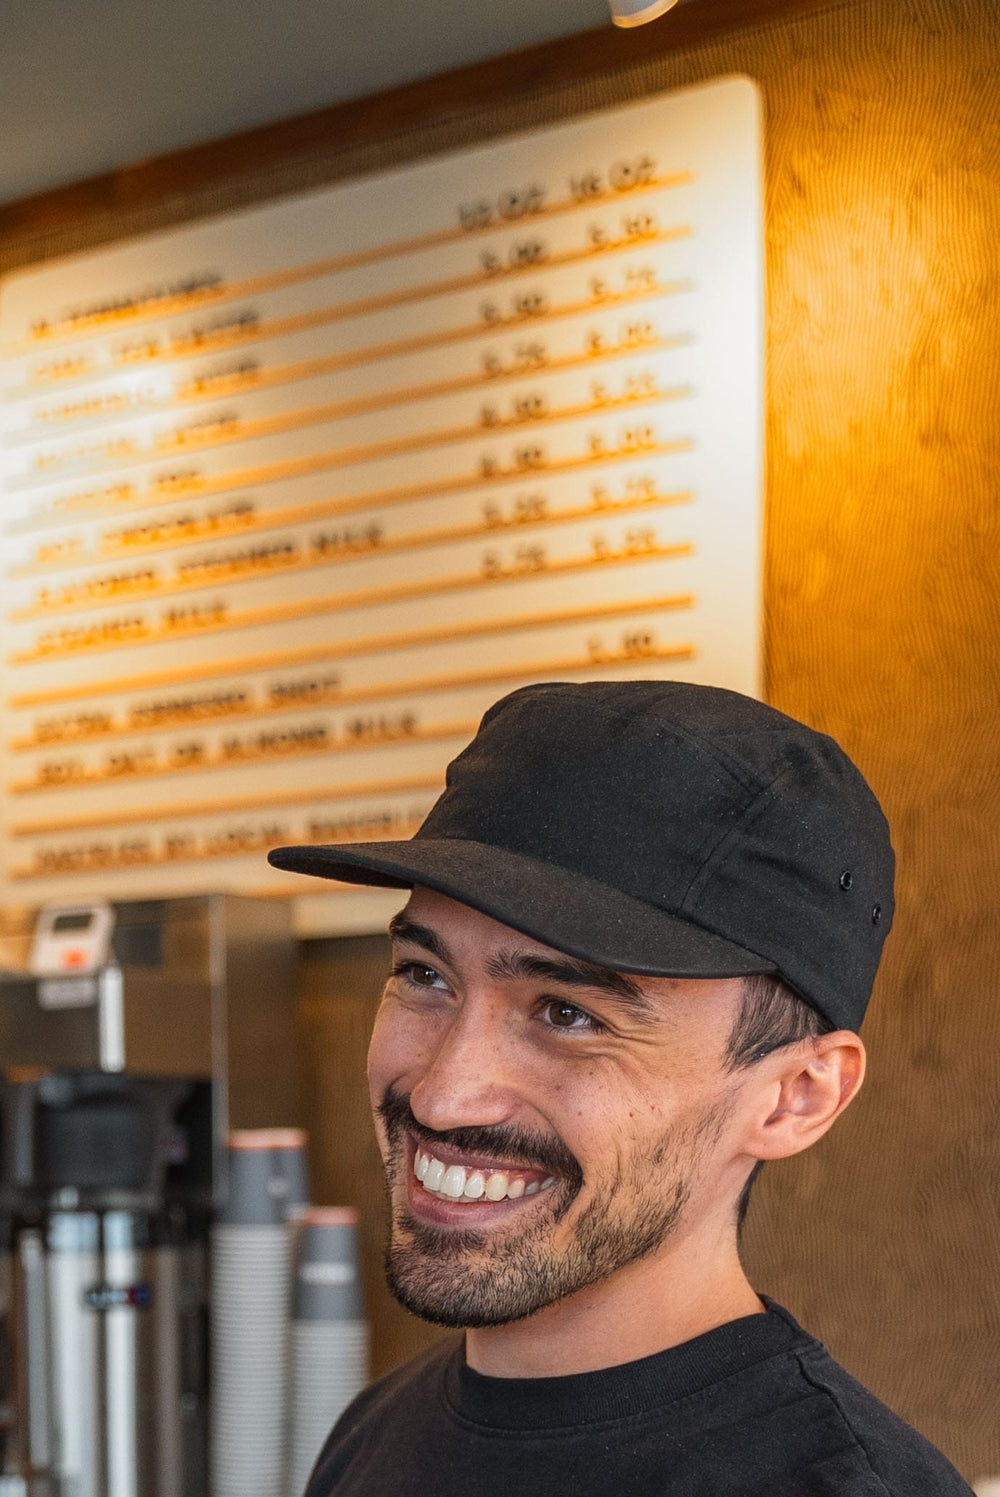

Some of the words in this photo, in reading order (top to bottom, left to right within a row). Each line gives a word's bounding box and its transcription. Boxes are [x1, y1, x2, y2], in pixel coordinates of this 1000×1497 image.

[311, 521, 387, 556] MILK
[161, 598, 231, 628] MILK
[348, 708, 422, 740] MILK
